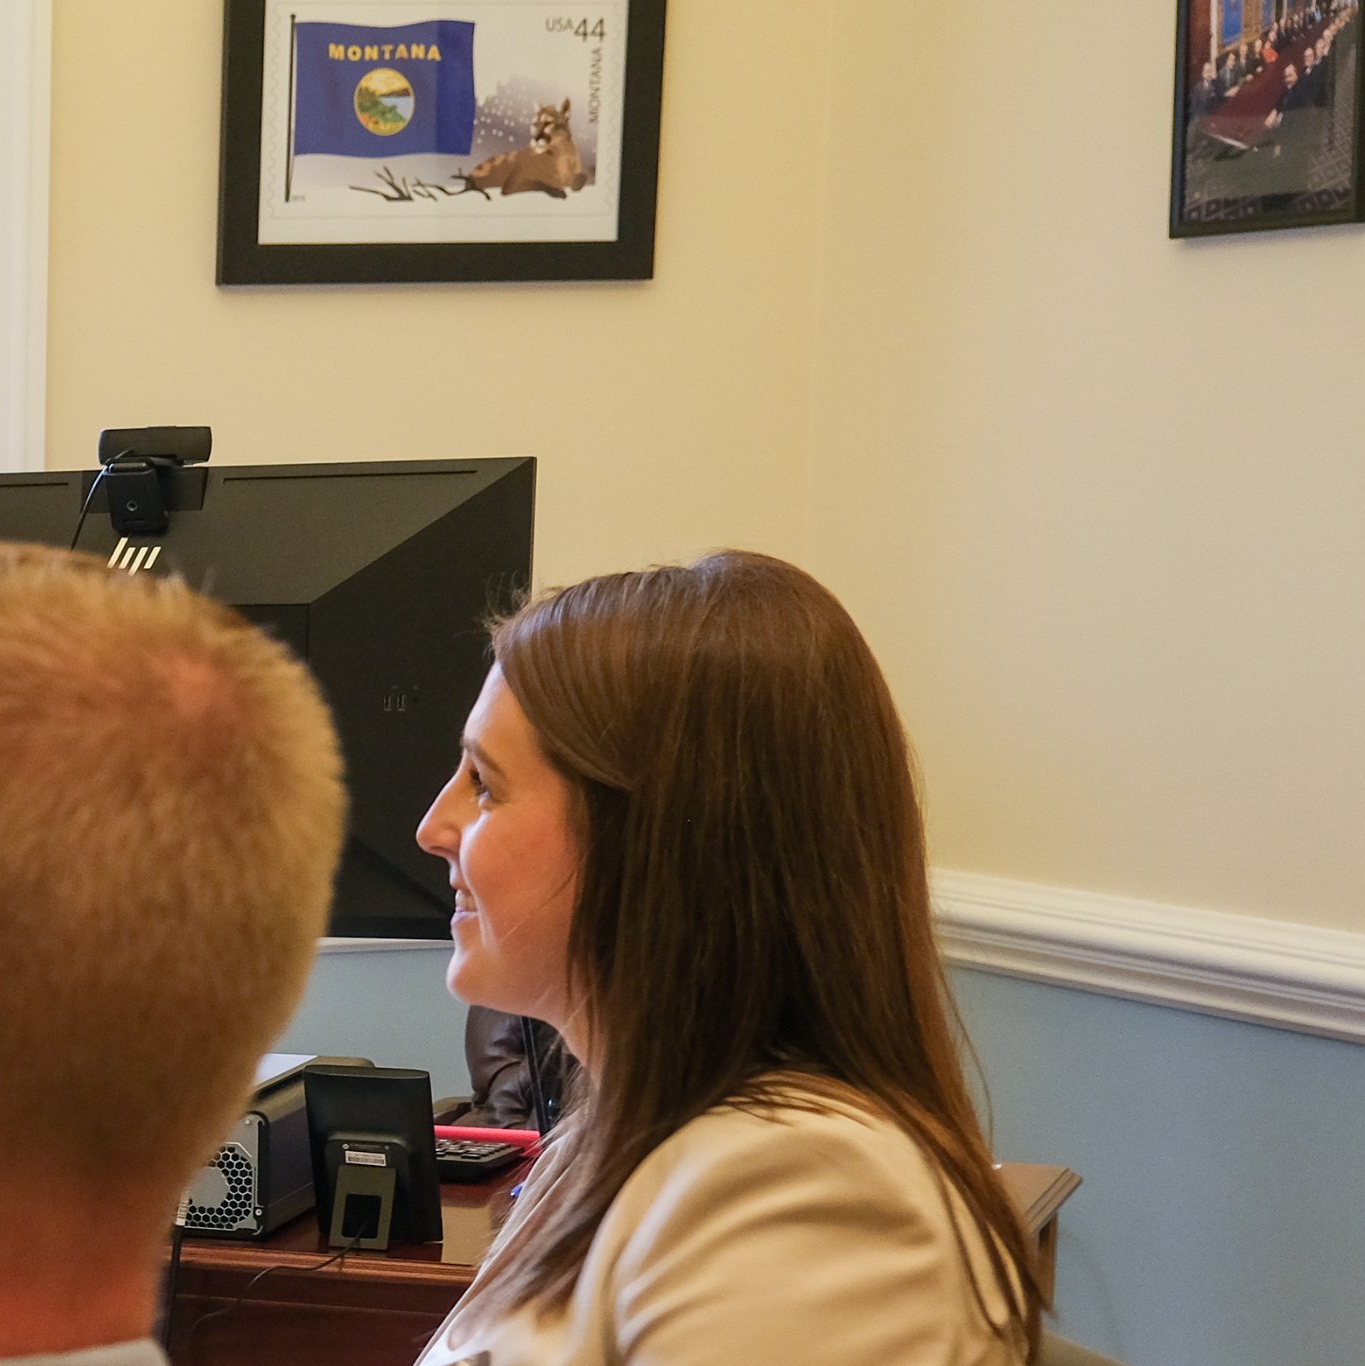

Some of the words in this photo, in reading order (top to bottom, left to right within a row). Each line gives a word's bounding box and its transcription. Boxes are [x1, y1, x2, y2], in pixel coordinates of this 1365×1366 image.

[545, 16, 573, 33] USA
[573, 16, 607, 43] 44
[328, 42, 442, 62] MONTANA
[587, 46, 603, 124] MONTANA
